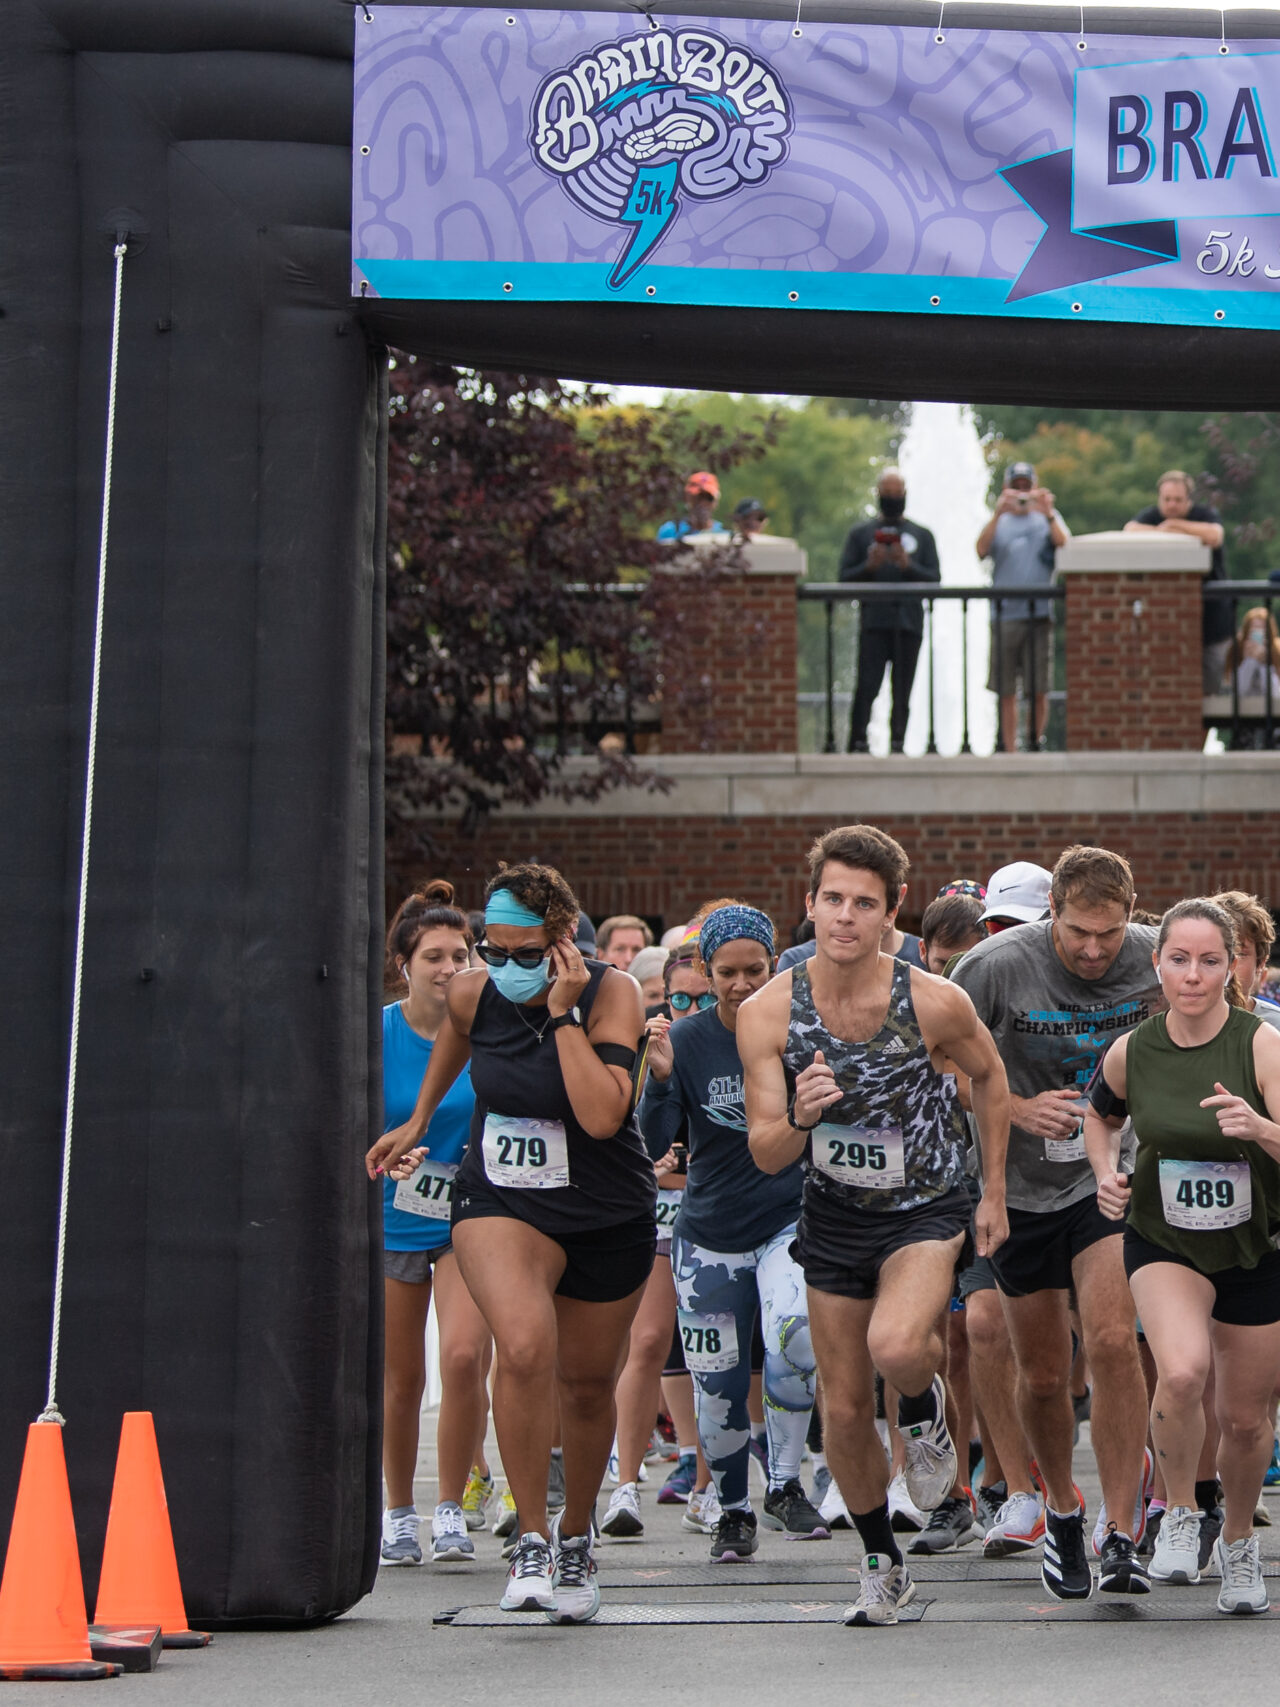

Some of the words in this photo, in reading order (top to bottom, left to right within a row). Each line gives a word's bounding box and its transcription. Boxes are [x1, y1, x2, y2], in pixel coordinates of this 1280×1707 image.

[1013, 1005, 1150, 1037] CHAMPIONSHIPS
[1028, 1010, 1073, 1021] CROSS
[1077, 1000, 1140, 1021] COUNTRY
[1058, 1003, 1081, 1013] BIG
[1086, 1001, 1113, 1012] TEN
[882, 1046, 910, 1055] adidas
[708, 1074, 740, 1095] 6TH
[497, 1135, 547, 1167] 279
[828, 1140, 887, 1170] 295
[1176, 1179, 1234, 1209] 489
[682, 1326, 721, 1354] 278
